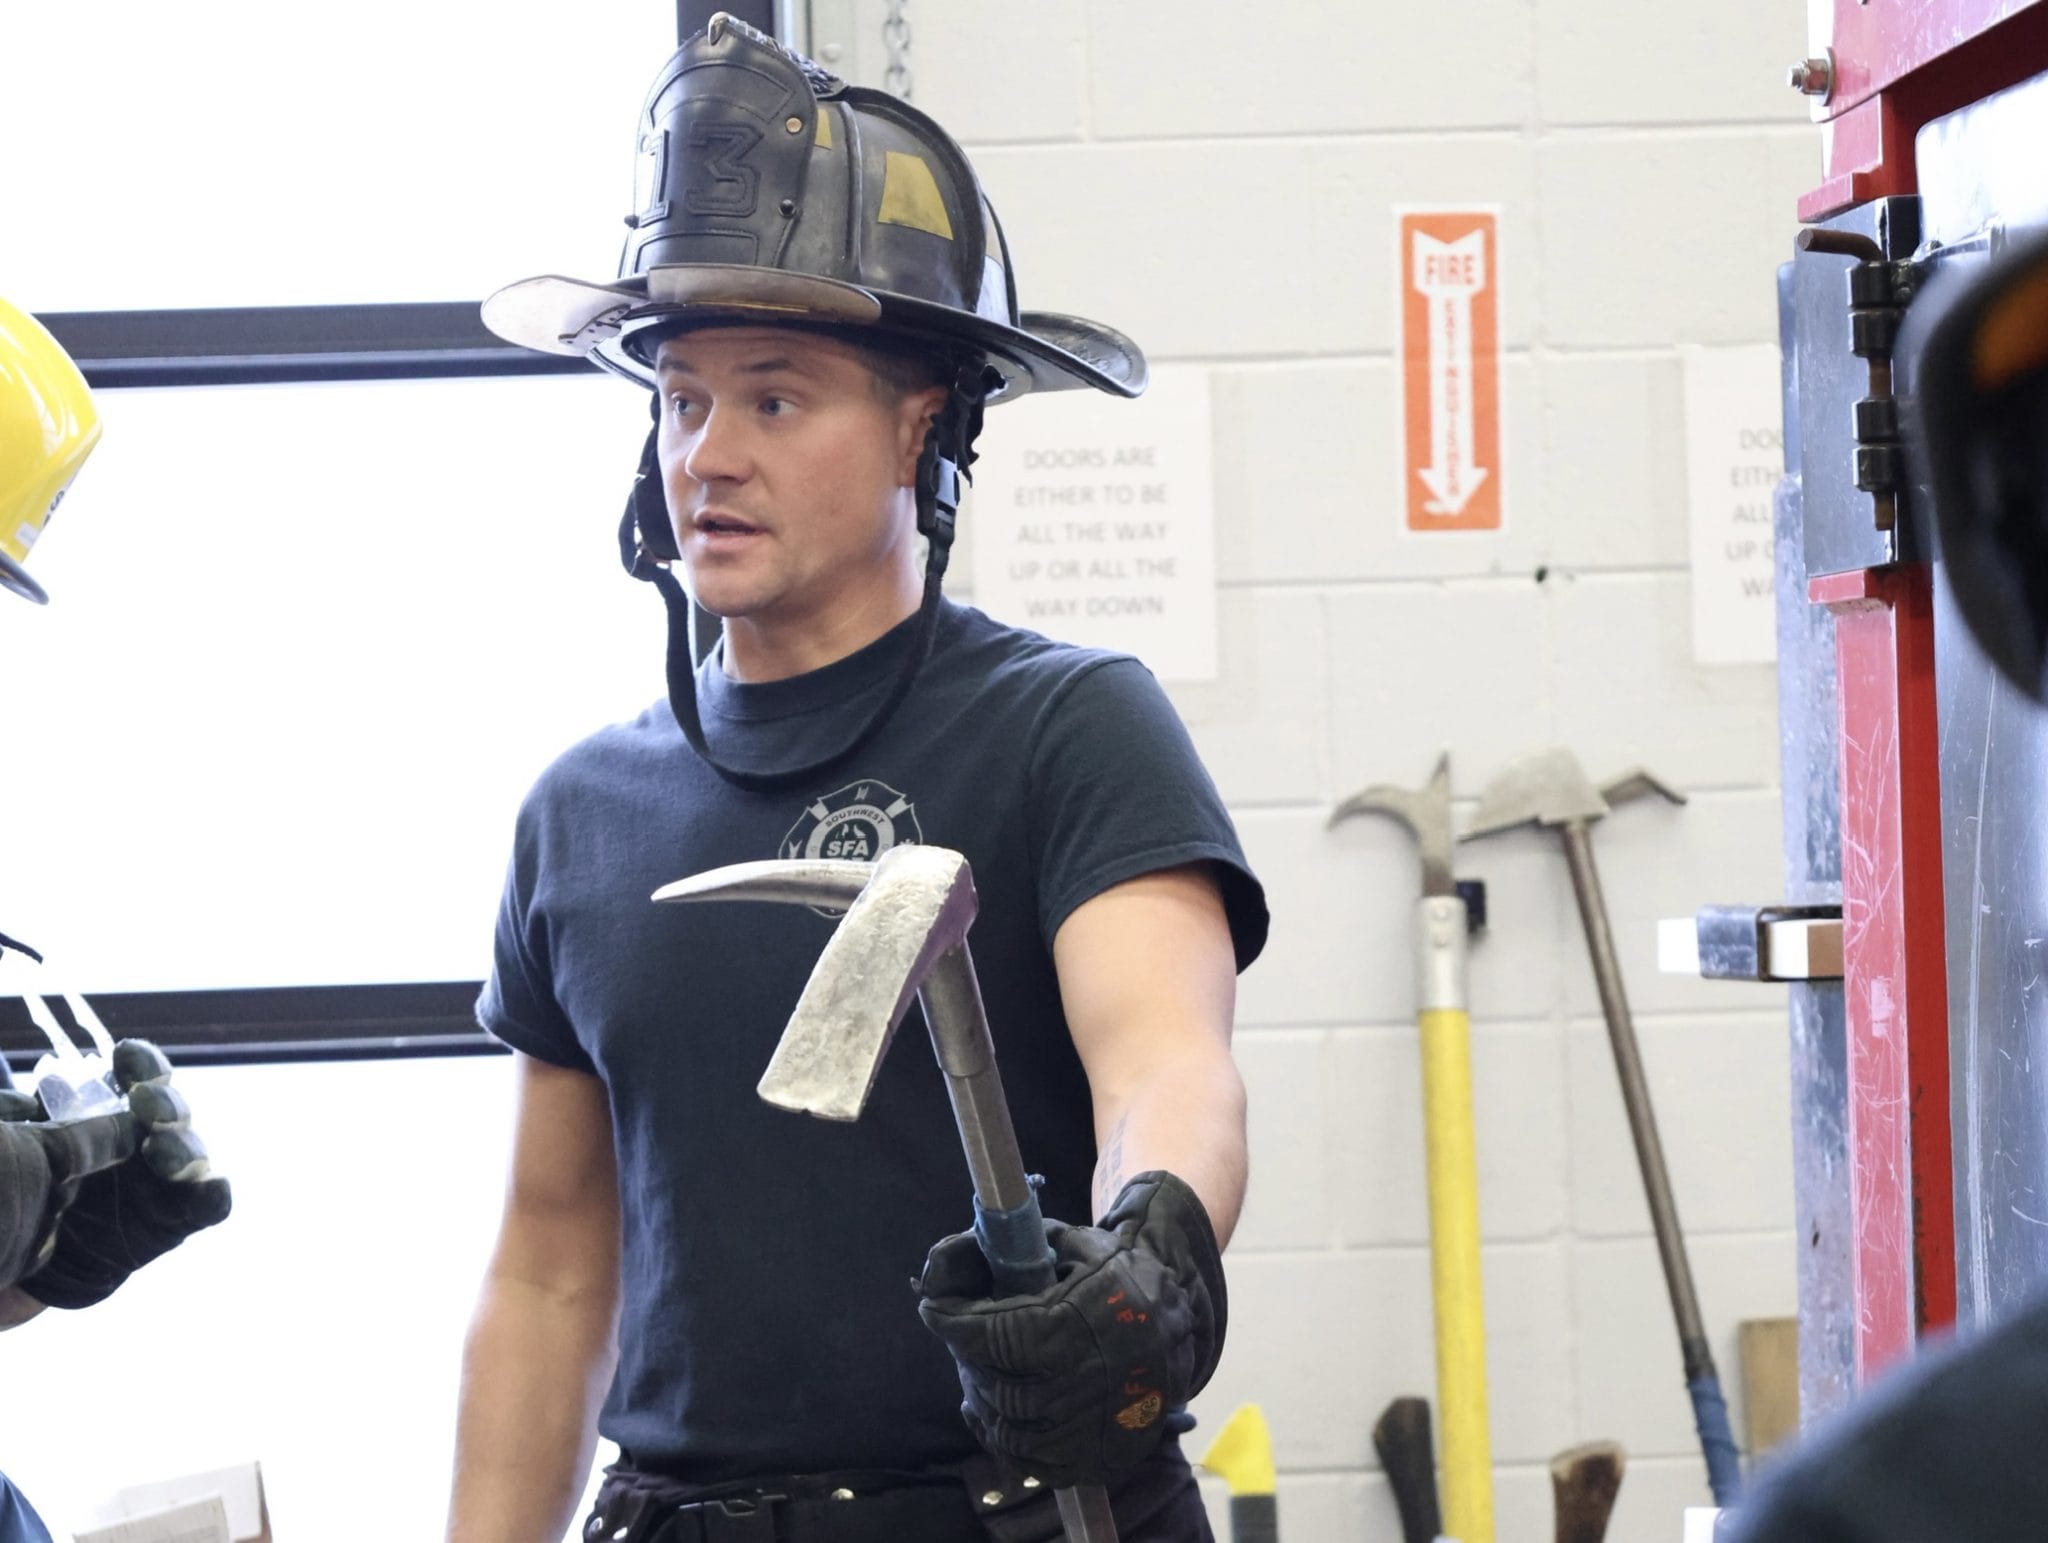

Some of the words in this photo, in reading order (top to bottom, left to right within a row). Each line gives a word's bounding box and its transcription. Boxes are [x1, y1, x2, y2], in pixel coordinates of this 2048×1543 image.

[640, 122, 765, 228] 13
[1425, 254, 1474, 285] FIRE
[1023, 448, 1106, 469] DOORS
[1113, 446, 1156, 466] ARE
[1013, 486, 1095, 507] EITHER
[1103, 484, 1134, 504] TO
[1141, 483, 1168, 503] BE
[1017, 525, 1055, 543] ALL
[1064, 523, 1105, 542] THE
[1114, 522, 1167, 541] WAY
[1725, 540, 1757, 560] UP
[1008, 560, 1041, 580] UP
[1047, 559, 1081, 579] OR
[1088, 559, 1126, 578] ALL
[1134, 557, 1176, 577] THE
[1025, 599, 1077, 617] WAY
[1086, 596, 1163, 616] DOWN
[825, 808, 886, 827] SOUTHWEST
[826, 839, 869, 857] SFA
